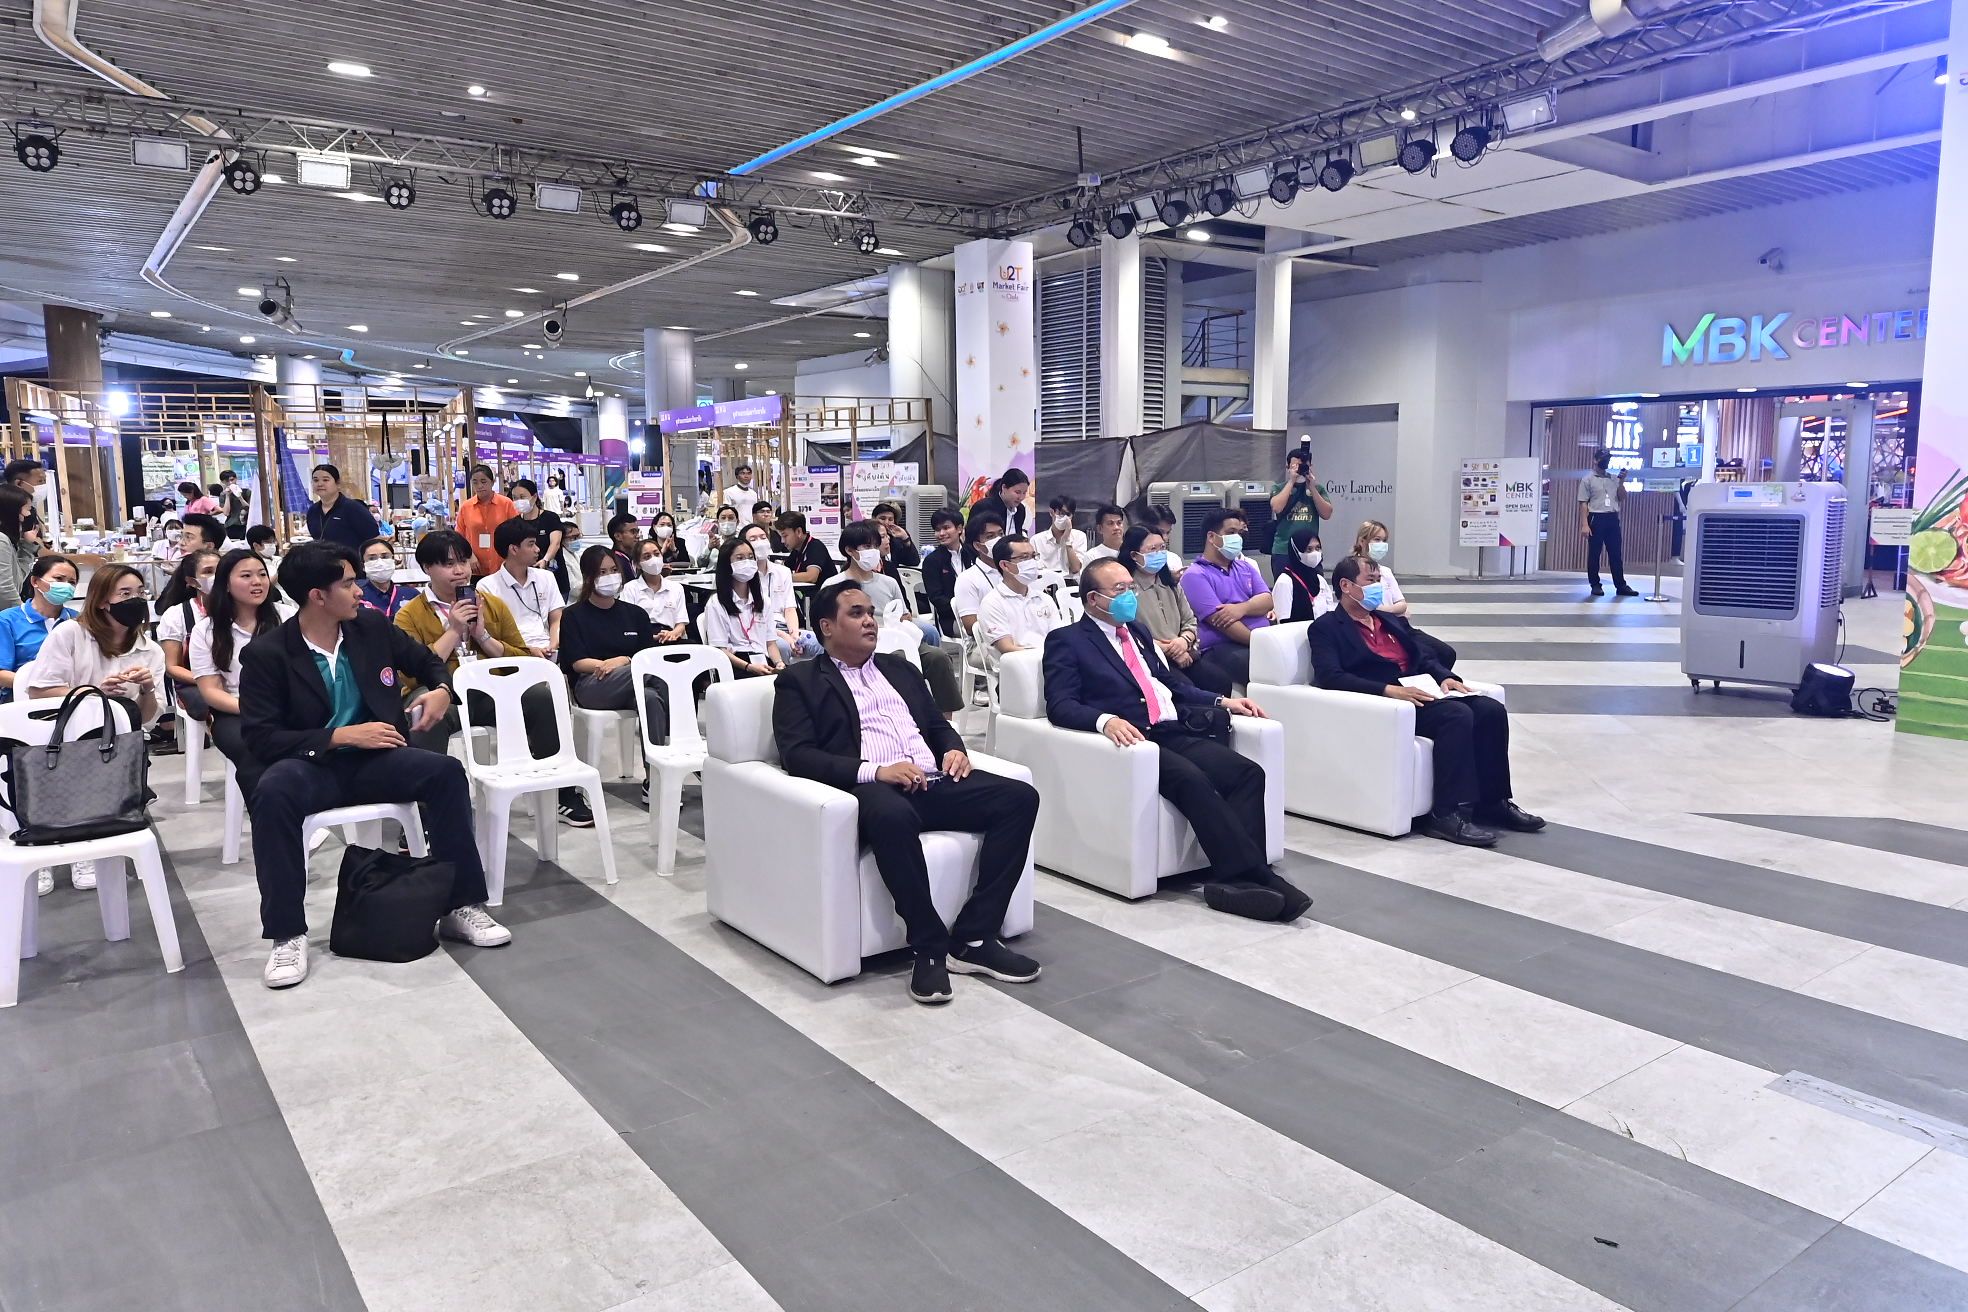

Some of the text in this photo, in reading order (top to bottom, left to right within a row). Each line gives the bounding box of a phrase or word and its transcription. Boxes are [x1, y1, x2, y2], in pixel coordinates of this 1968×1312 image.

[1000, 265, 1023, 281] U2T
[992, 281, 1015, 291] Market
[1017, 283, 1029, 292] Fair
[1662, 312, 1792, 367] MBK
[1326, 480, 1393, 497] Guy Laroche
[1505, 482, 1533, 492] MBK
